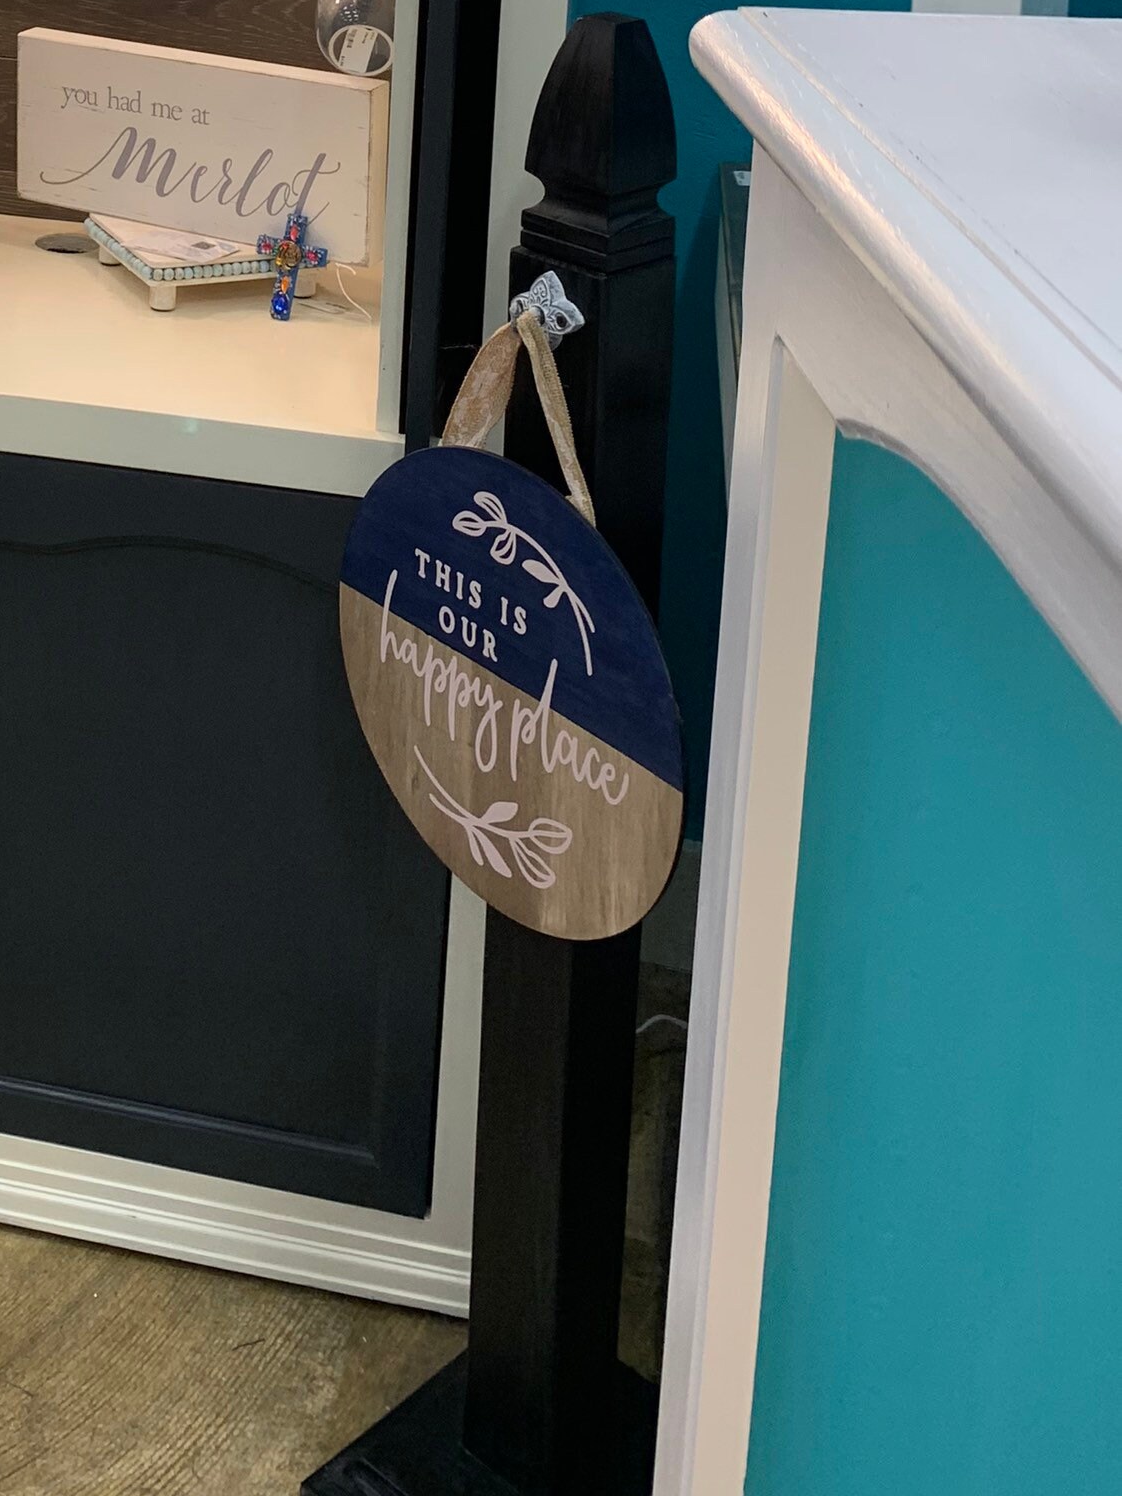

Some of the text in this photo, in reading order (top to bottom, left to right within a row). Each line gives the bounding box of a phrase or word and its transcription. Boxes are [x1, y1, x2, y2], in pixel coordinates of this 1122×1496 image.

[60, 84, 211, 126] you had me at
[414, 548, 529, 636] THIS IS
[438, 605, 499, 663] OUR
[379, 568, 631, 806] happy place
